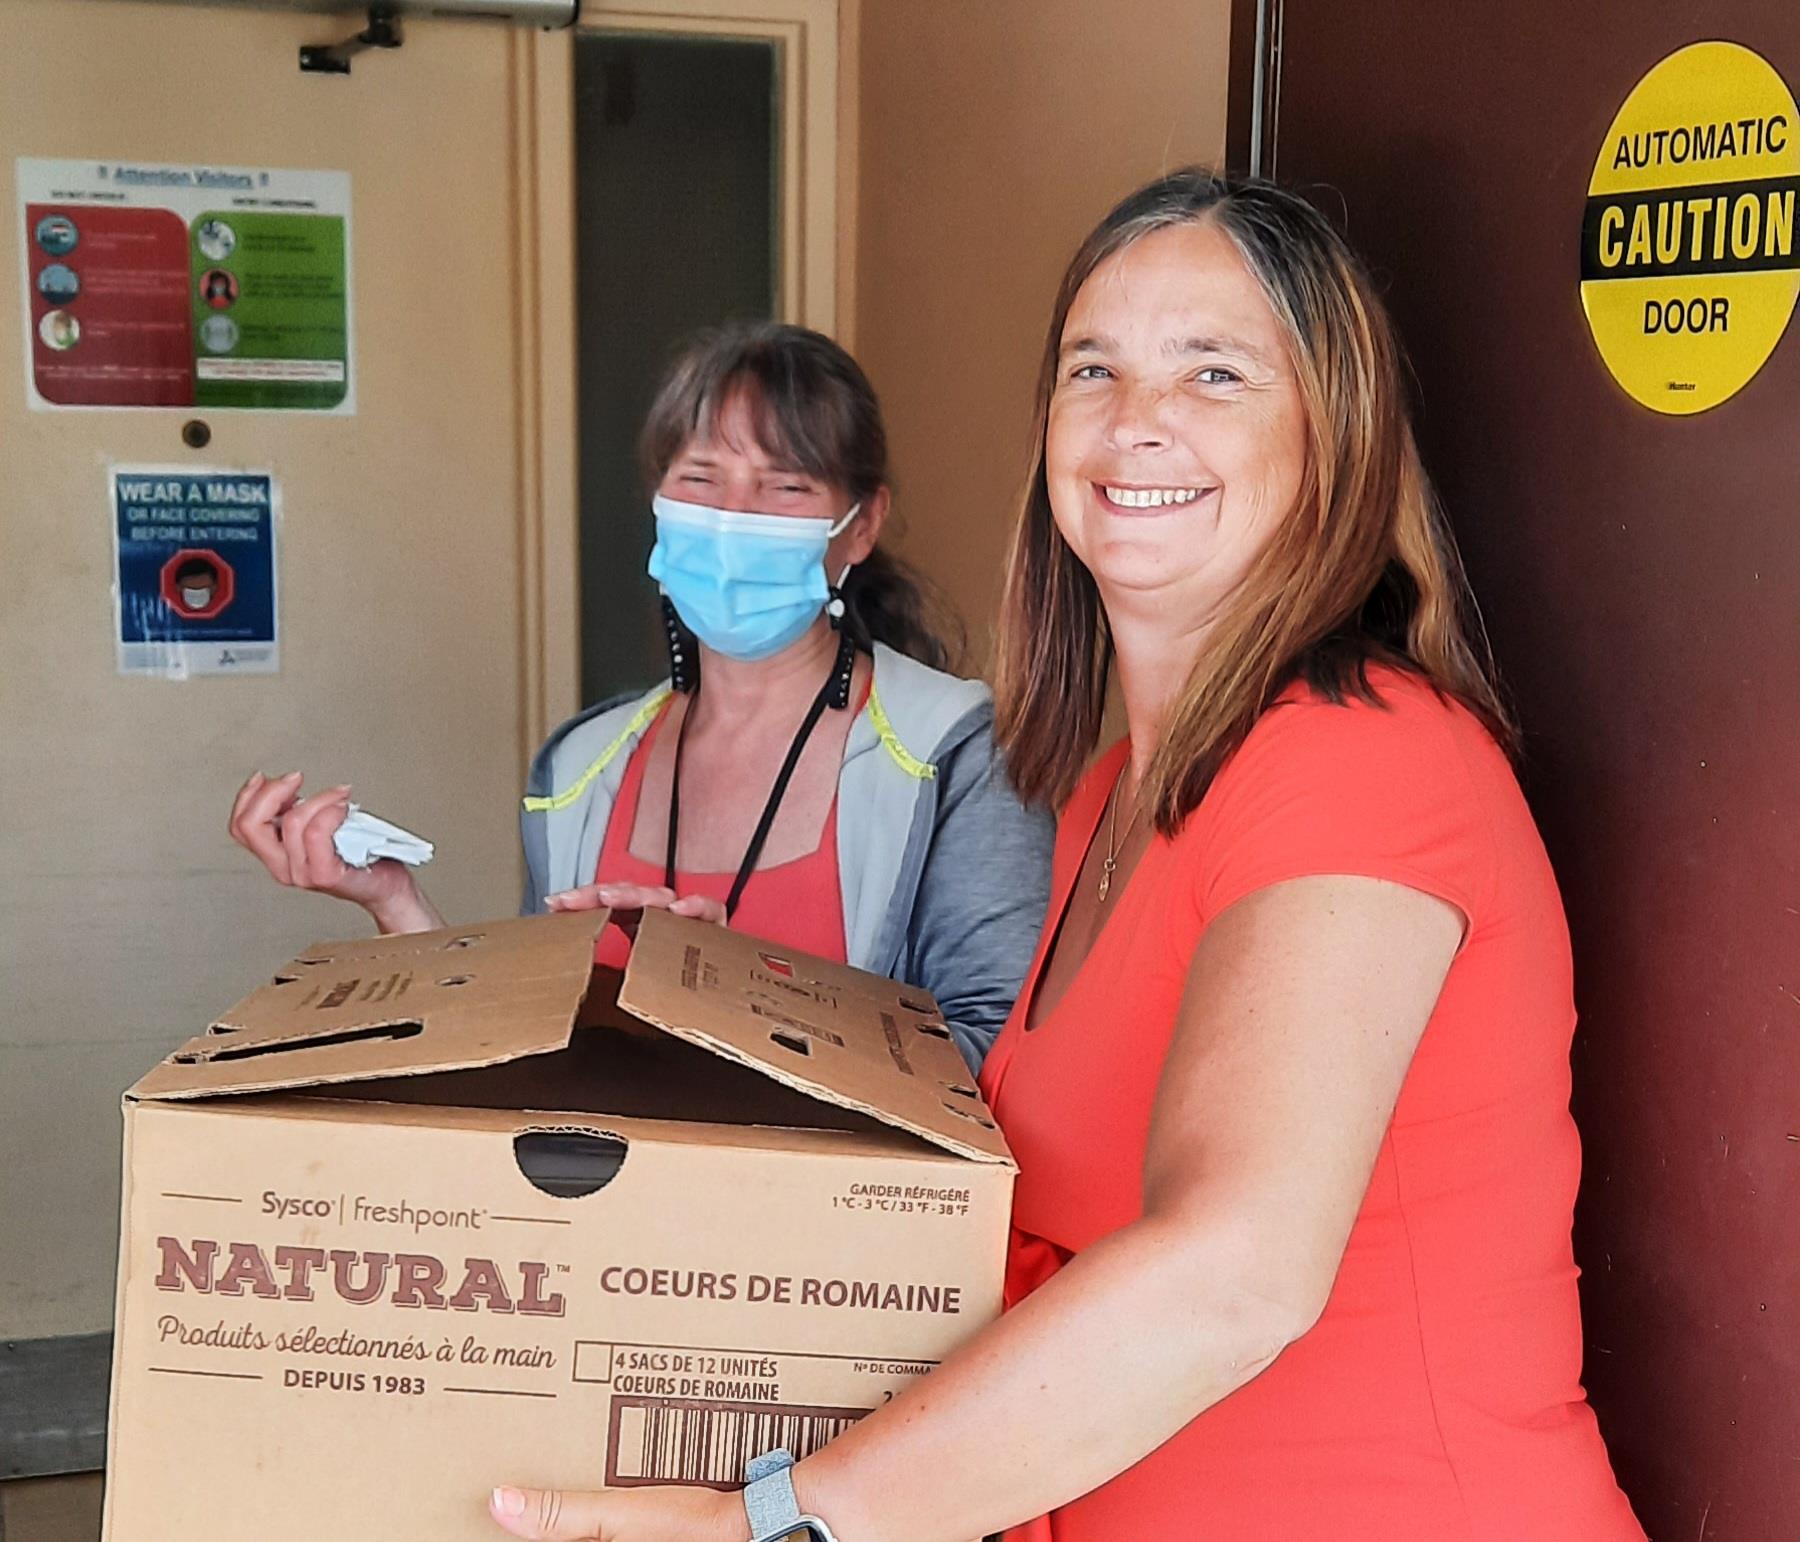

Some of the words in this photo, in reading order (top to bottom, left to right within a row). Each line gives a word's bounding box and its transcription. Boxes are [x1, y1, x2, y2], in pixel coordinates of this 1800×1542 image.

[1613, 115, 1787, 169] AUTOMATIC
[1599, 190, 1795, 268] CAUTION
[1643, 298, 1729, 334] DOOR
[118, 482, 183, 501] WEAR
[187, 483, 203, 501] A
[207, 483, 267, 502] MASK
[127, 506, 148, 522] OR
[151, 506, 186, 522] FACE
[190, 507, 260, 522] COVERING
[131, 526, 186, 541] BEFORE
[190, 527, 258, 541] ENTERING
[261, 1191, 332, 1219] Sysco
[850, 1183, 902, 1198] GARDER
[905, 1186, 970, 1202] RÉFRIGÉRÉ
[899, 1202, 913, 1212] 33
[940, 1204, 953, 1215] 38
[155, 1236, 566, 1317] NATURAL
[600, 1266, 737, 1301] COEURS
[746, 1275, 792, 1305] DE
[800, 1278, 961, 1314] ROMAINE
[157, 1315, 270, 1350] Produits
[275, 1325, 431, 1361] sélectionnés
[436, 1336, 455, 1363] à
[460, 1336, 489, 1364] la
[492, 1344, 557, 1369] main
[615, 1353, 625, 1369] 4
[629, 1353, 668, 1371] SACS
[672, 1355, 692, 1372] DE
[698, 1356, 716, 1374] 12
[721, 1357, 777, 1377] UNITÉS
[870, 1363, 884, 1374] DE
[887, 1364, 934, 1375] COMMA
[284, 1369, 366, 1393] DEPUIS
[372, 1375, 426, 1395] 1983
[613, 1375, 676, 1395] COEURS
[680, 1378, 700, 1396] DE
[704, 1380, 779, 1401] ROMAINE
